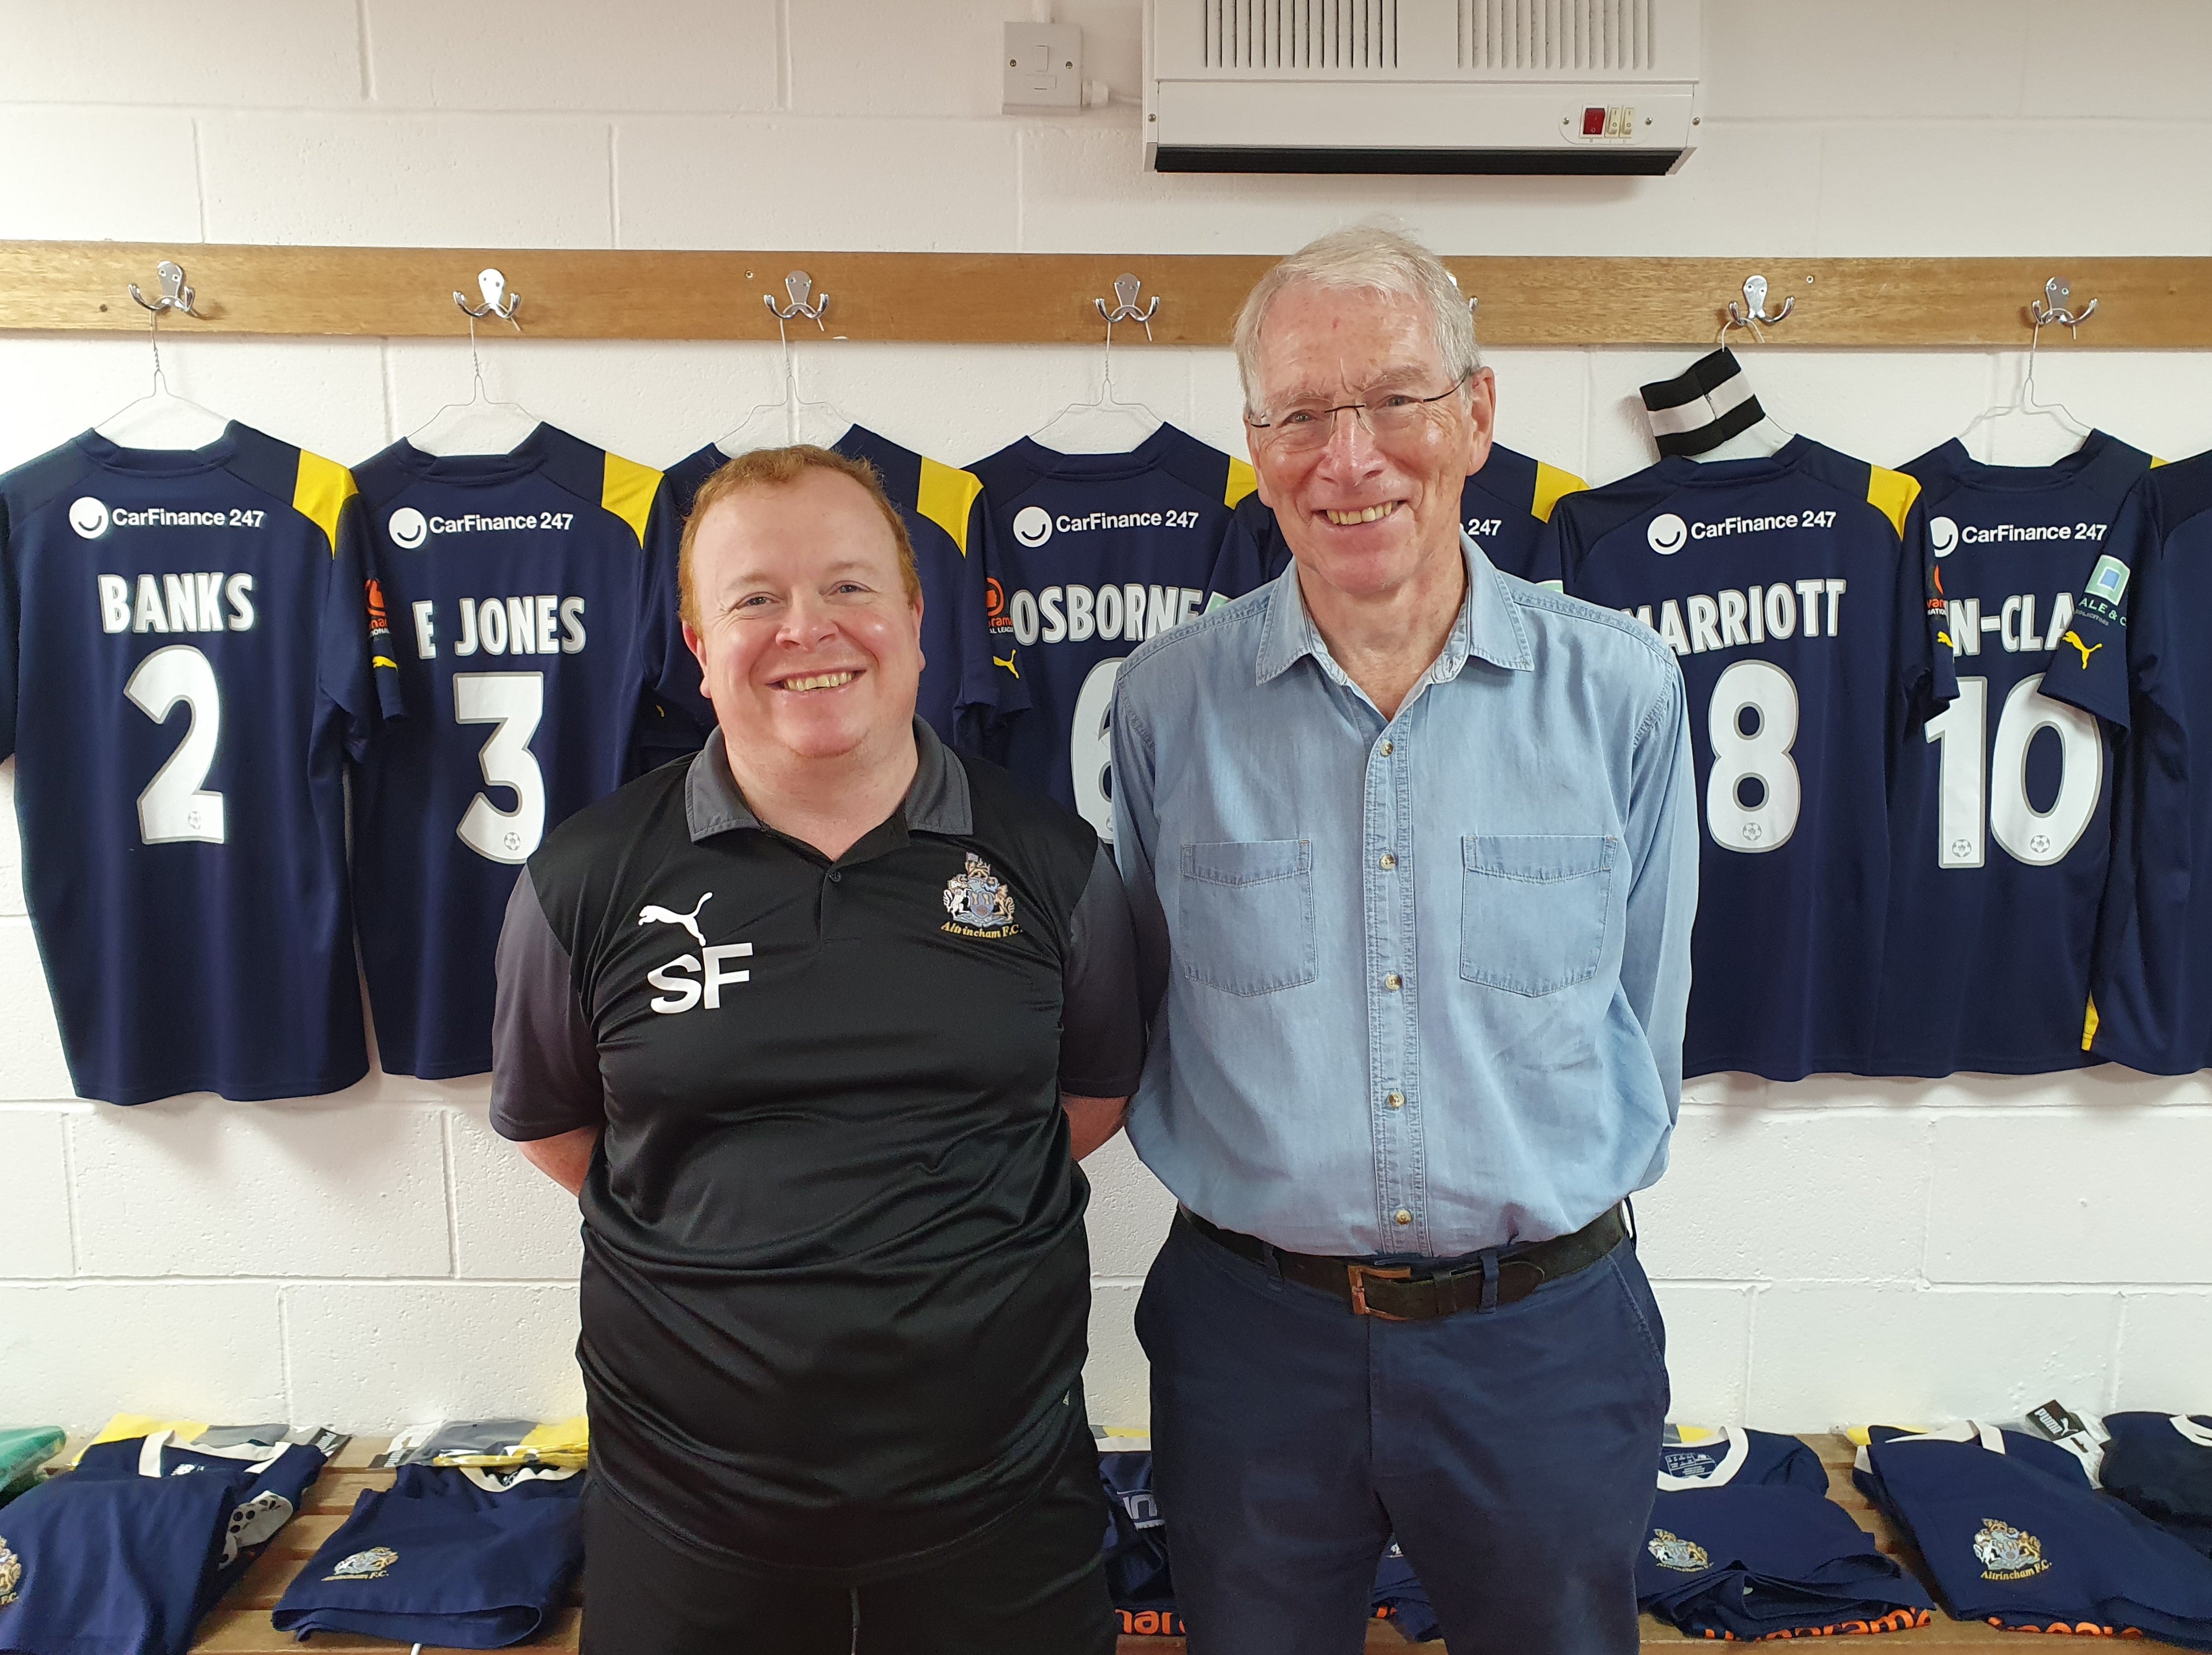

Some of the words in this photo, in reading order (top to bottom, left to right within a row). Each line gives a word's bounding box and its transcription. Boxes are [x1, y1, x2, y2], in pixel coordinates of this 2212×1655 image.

[112, 507, 225, 527] CarFinance
[229, 509, 264, 528] 247
[429, 513, 536, 534] CarFinance
[540, 512, 573, 530] 247
[1056, 511, 1161, 533] CarFinance
[1166, 509, 1199, 529] 247
[1691, 511, 1798, 540] CarFinance
[1801, 511, 1836, 529] 247
[1962, 524, 2071, 544] CarFinance
[2074, 524, 2107, 541] 247
[97, 573, 256, 633] BANKS
[412, 600, 436, 659] E
[455, 595, 586, 656] JONES
[2108, 609, 2117, 621] &
[123, 644, 225, 844] 2
[453, 671, 545, 864] 3
[1707, 659, 1801, 853] 8
[1925, 672, 2103, 868] 10
[647, 942, 754, 1014] SF
